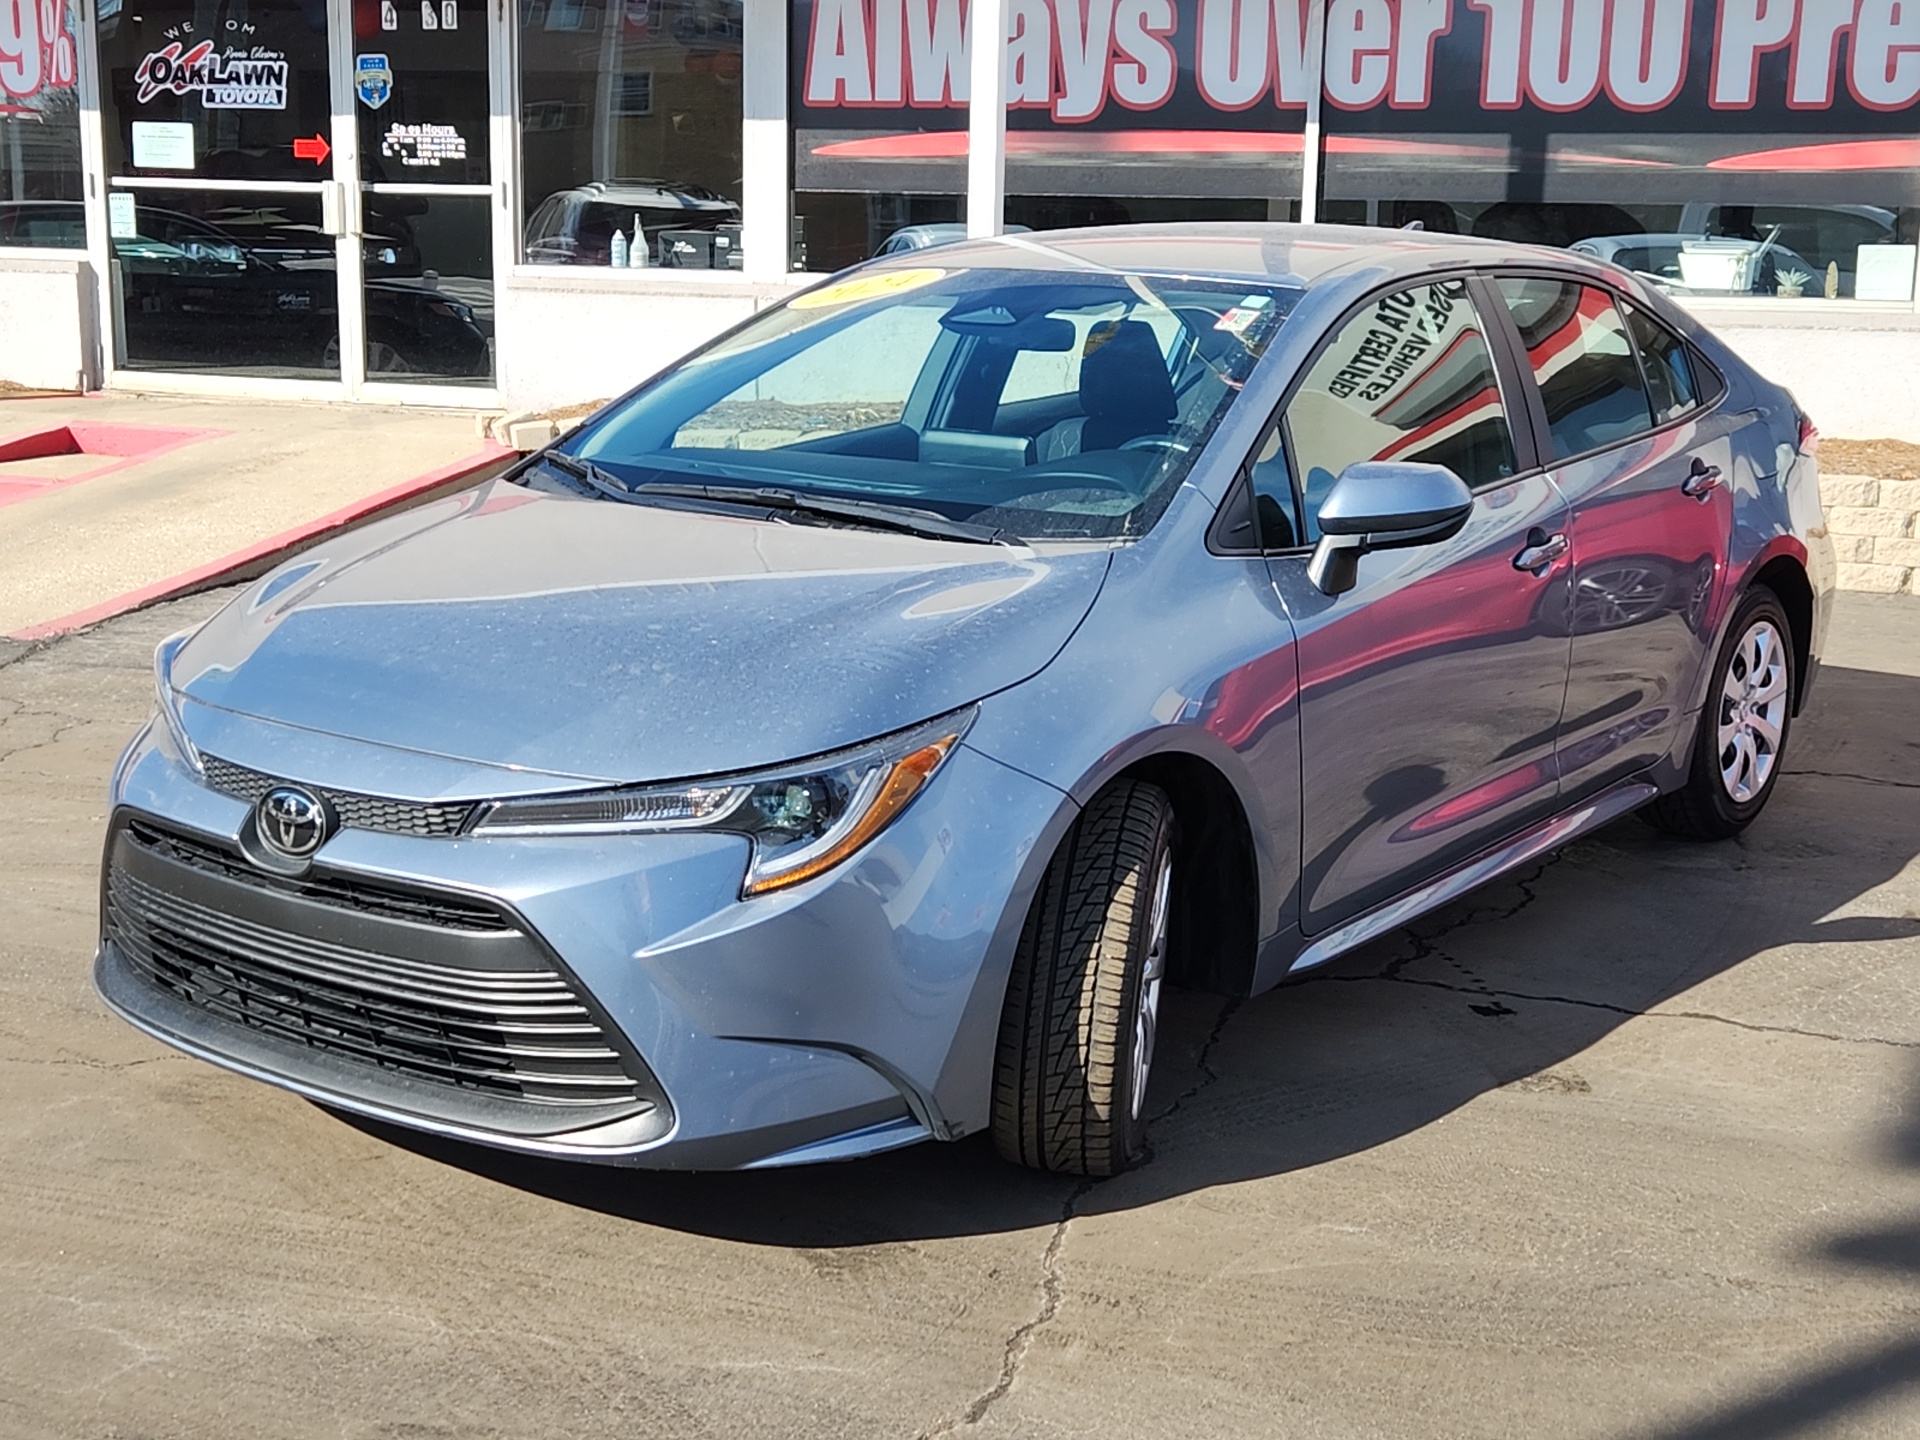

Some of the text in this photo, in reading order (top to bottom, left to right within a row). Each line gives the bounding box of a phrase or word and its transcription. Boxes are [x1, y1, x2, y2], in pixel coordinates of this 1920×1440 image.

[804, 0, 1177, 121] Always
[1195, 0, 1451, 110] Over
[1468, 0, 1692, 111] 100
[213, 89, 278, 104] TOYOTA
